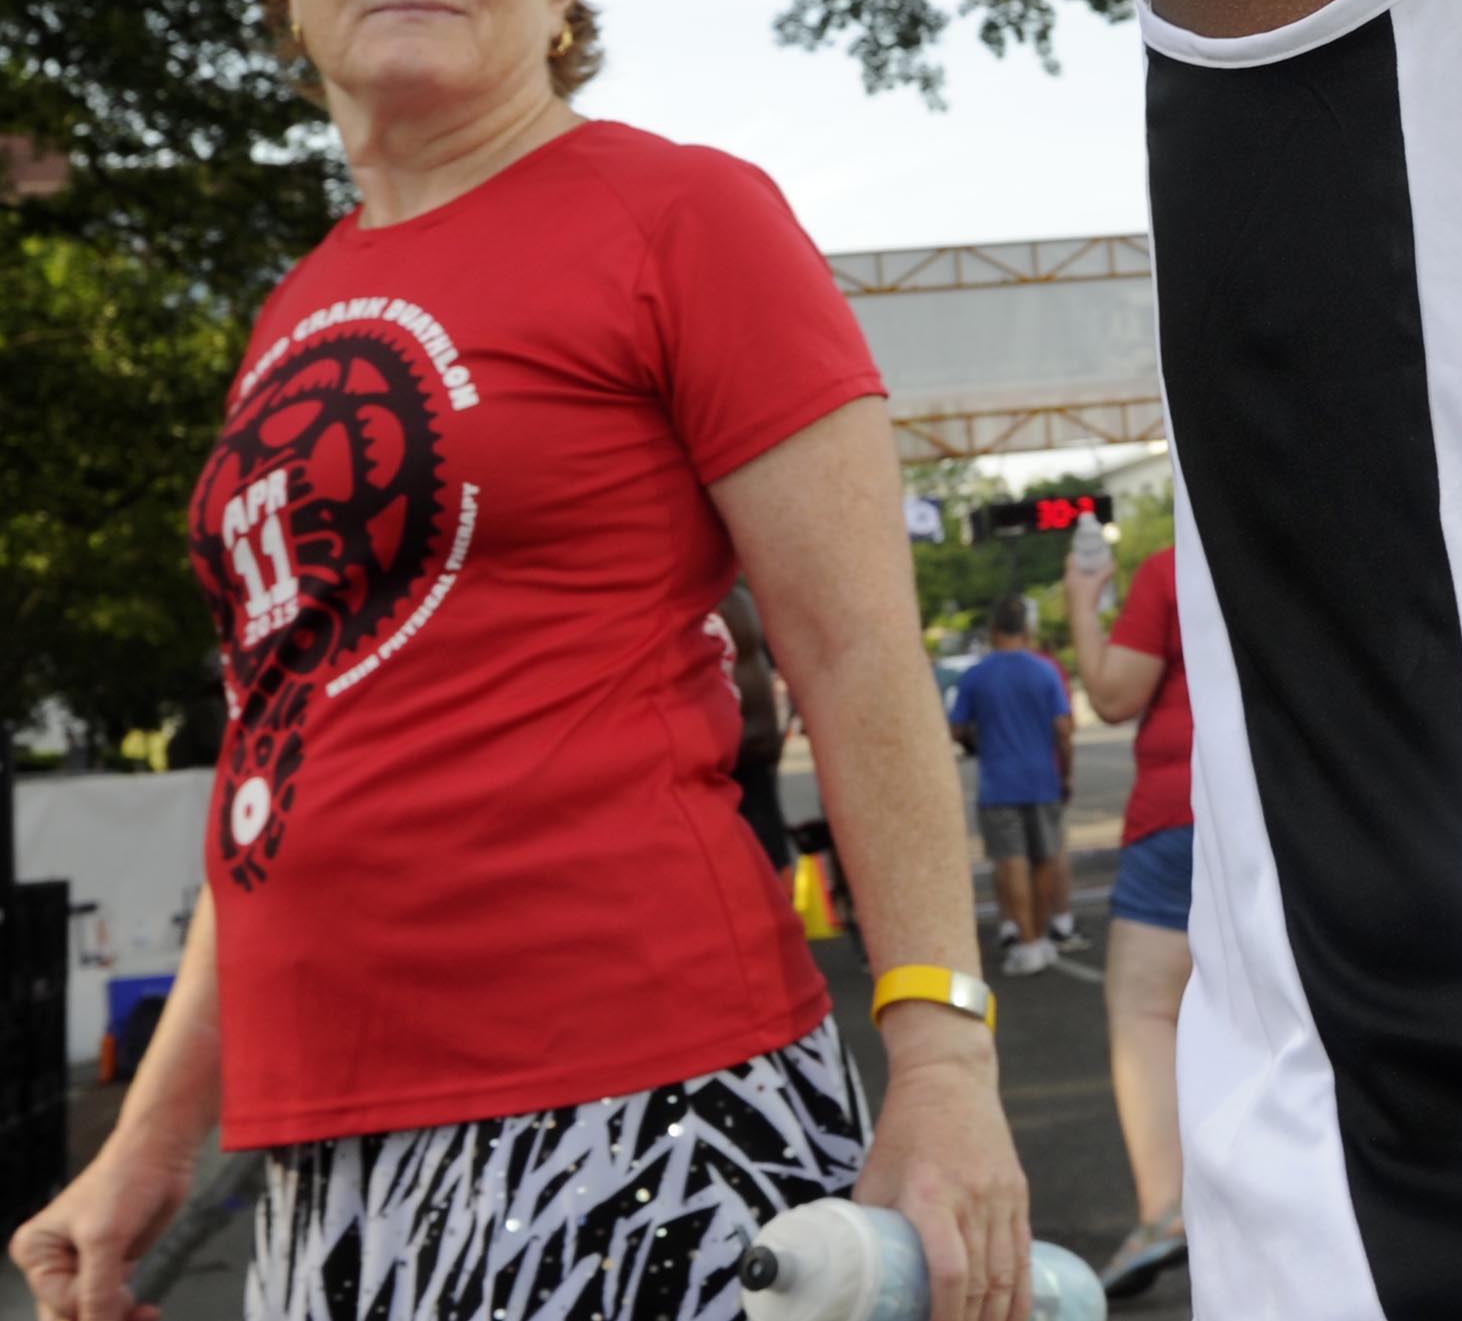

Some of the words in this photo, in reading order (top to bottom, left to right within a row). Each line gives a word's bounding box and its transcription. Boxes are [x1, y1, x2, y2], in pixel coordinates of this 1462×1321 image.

[383, 298, 480, 411] DUATHLON
[222, 468, 288, 551] APR
[233, 512, 299, 619] 11
[378, 573, 457, 659] PHYSICAL
[445, 481, 480, 570] THERAPY
[244, 596, 299, 648] 2015
